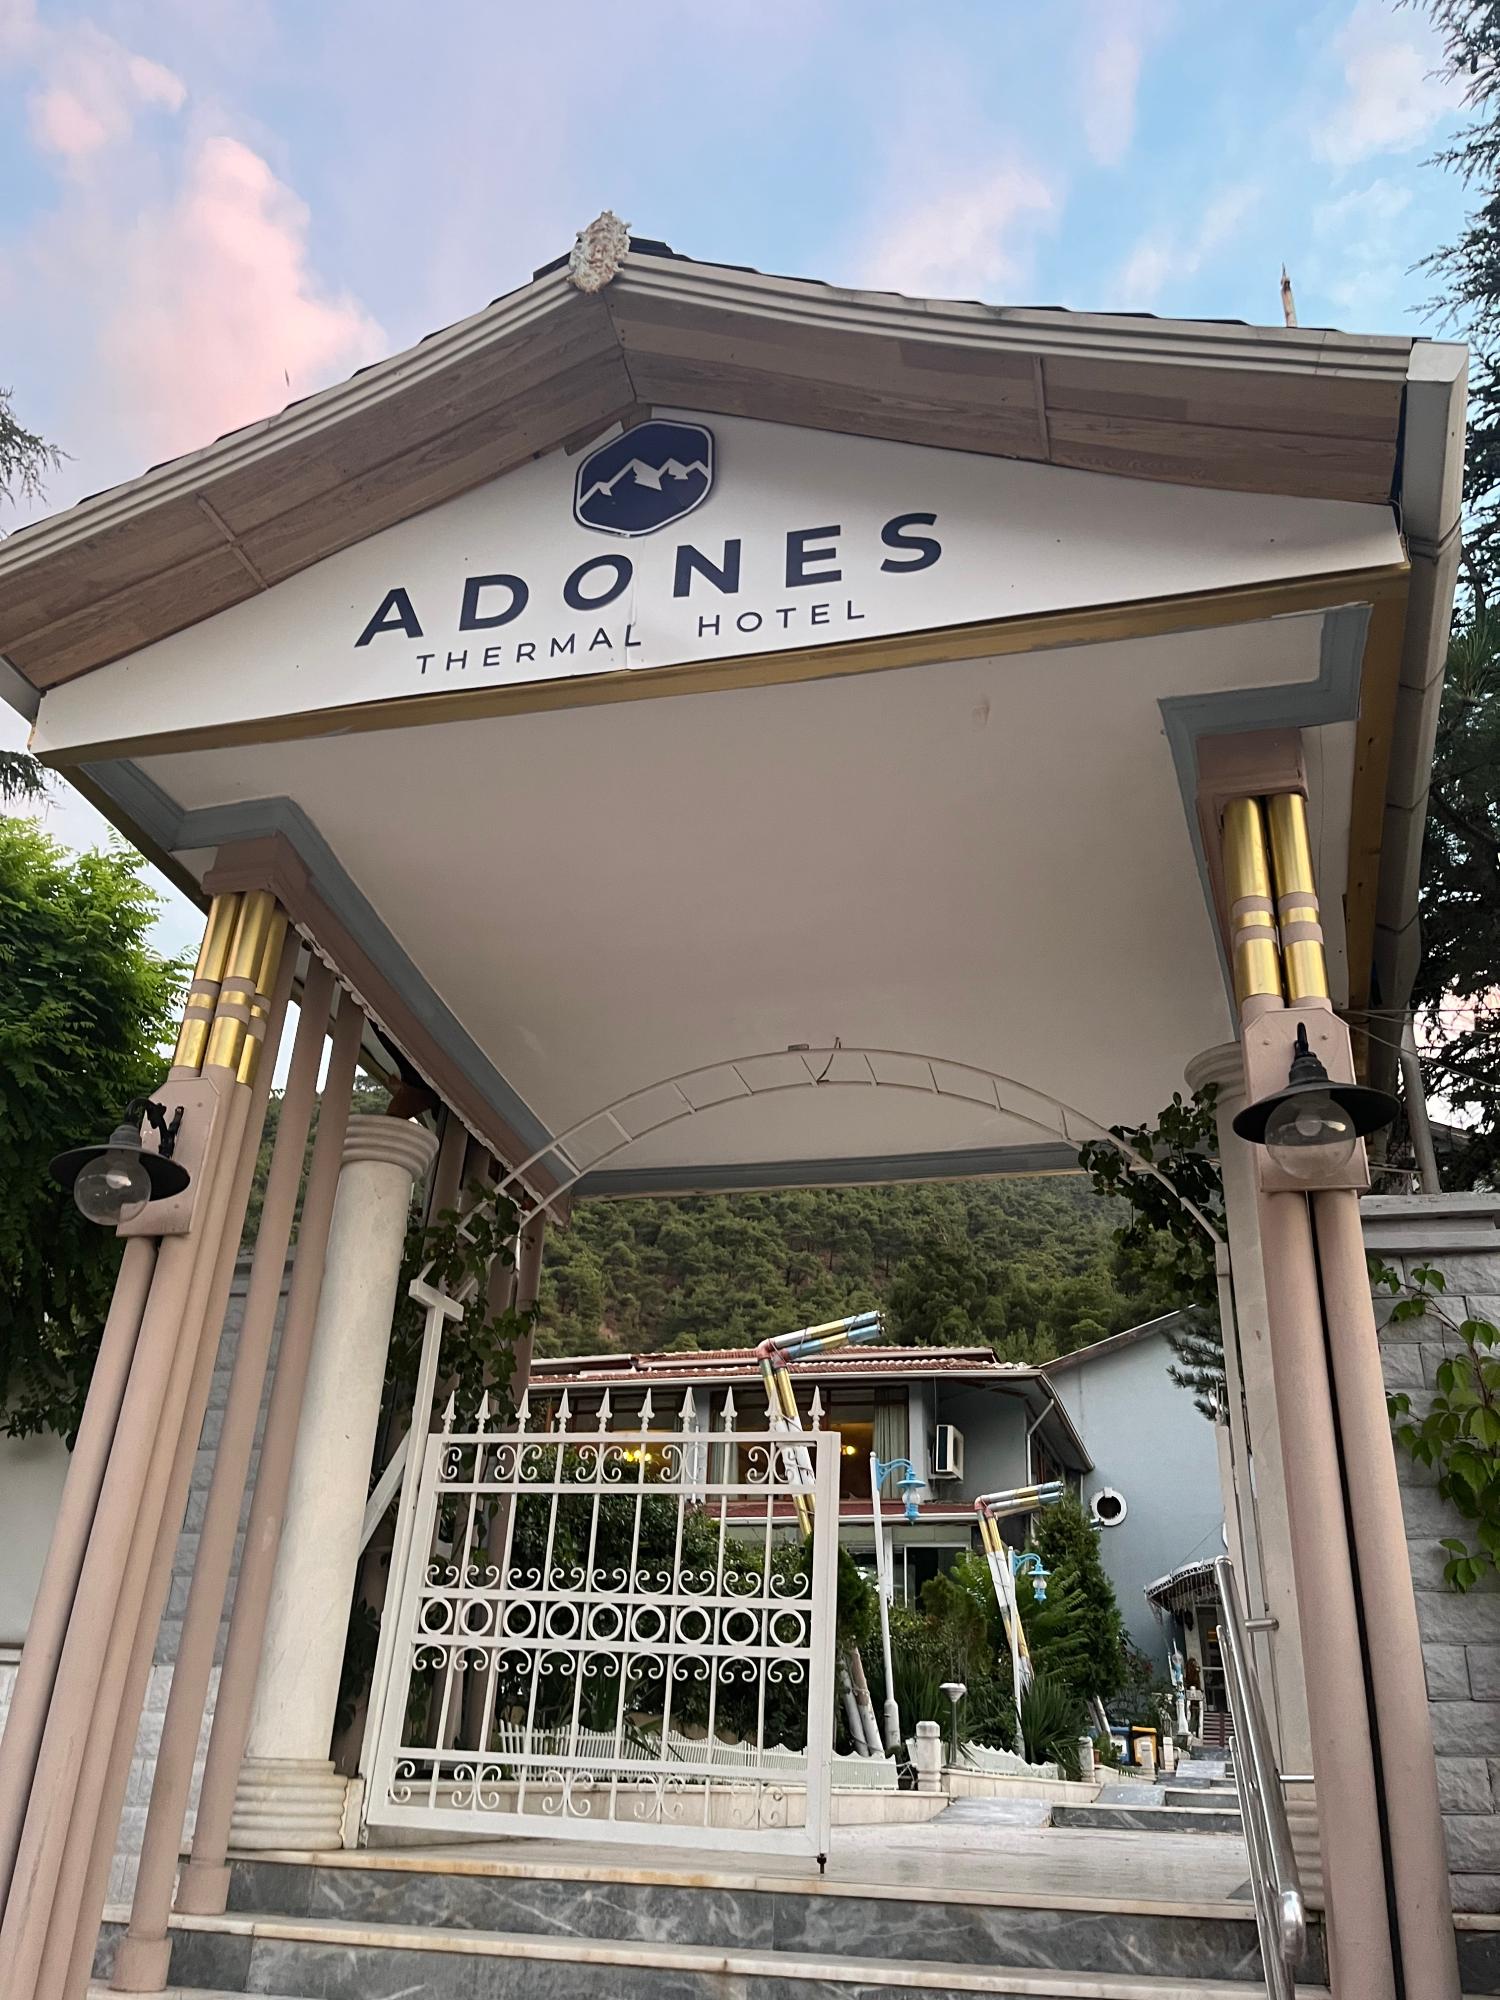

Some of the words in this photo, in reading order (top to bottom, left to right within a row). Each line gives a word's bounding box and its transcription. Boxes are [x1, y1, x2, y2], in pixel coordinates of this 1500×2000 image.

[354, 511, 942, 648] ADONES
[416, 623, 643, 675] THERMAL
[698, 600, 866, 638] HOTEL
